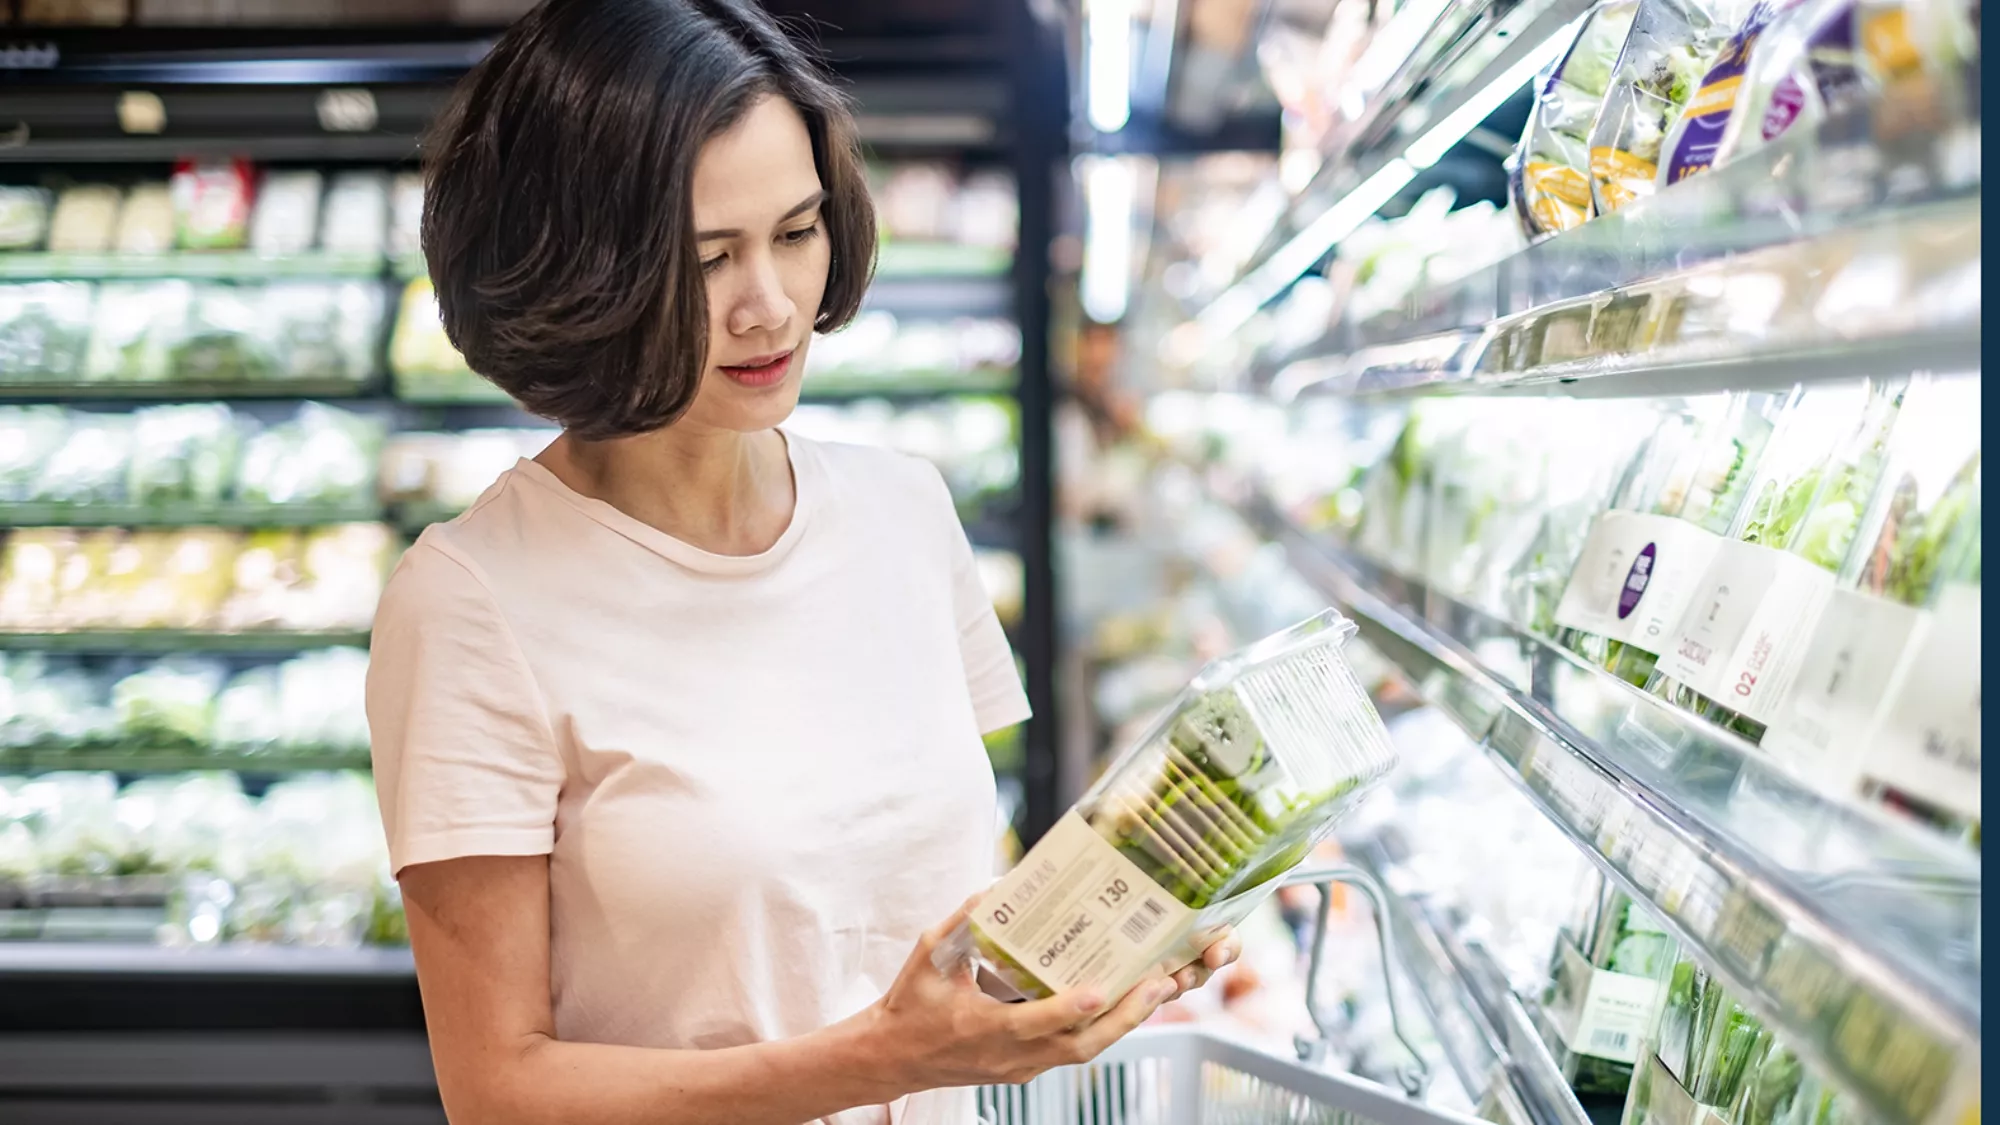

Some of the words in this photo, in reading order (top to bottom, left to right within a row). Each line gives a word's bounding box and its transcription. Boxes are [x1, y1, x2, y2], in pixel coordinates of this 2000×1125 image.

[1735, 671, 1757, 697] 02
[1098, 878, 1129, 909] 130
[993, 902, 1016, 925] 01
[1039, 912, 1094, 968] ORGANIC
